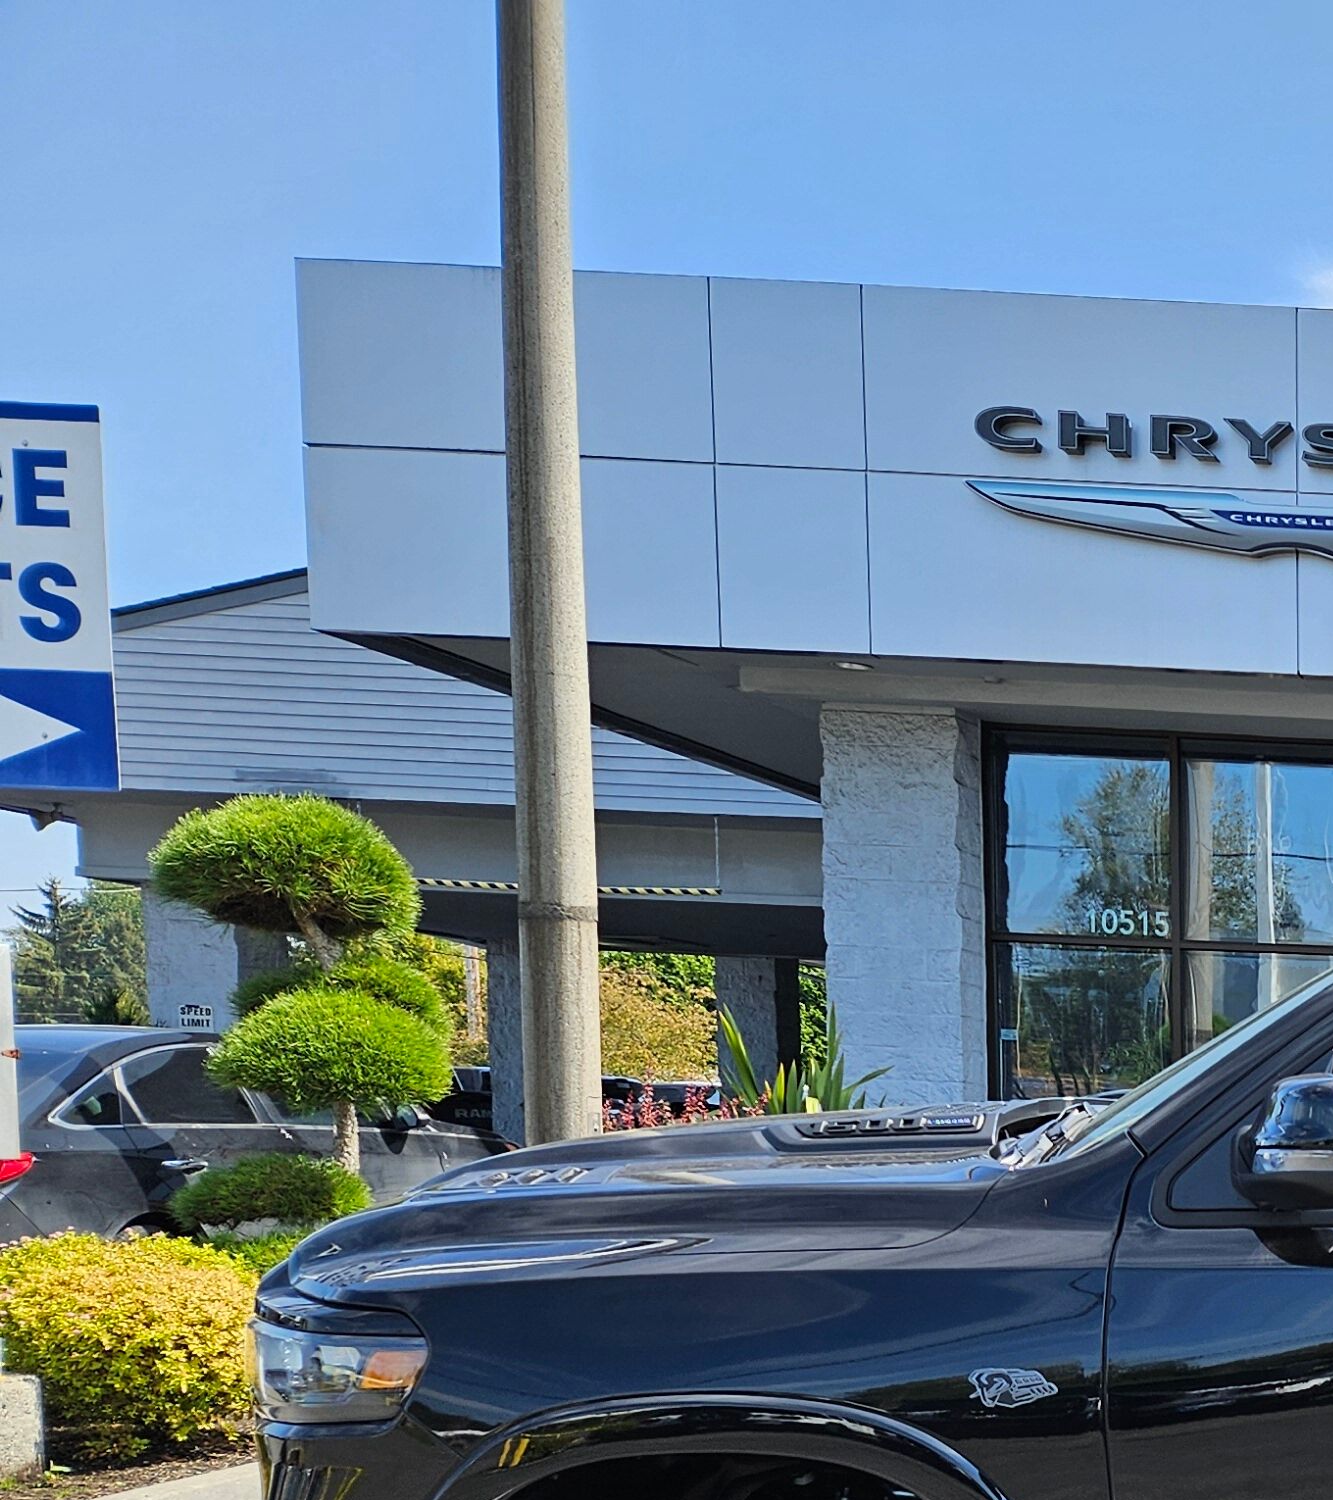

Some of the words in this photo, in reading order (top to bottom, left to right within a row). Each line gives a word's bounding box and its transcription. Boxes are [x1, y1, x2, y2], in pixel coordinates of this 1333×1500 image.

[0, 448, 71, 528] E
[0, 561, 82, 643] S
[1086, 908, 1170, 937] 10515
[180, 1006, 212, 1016] SPEED
[181, 1018, 211, 1027] LIMIT
